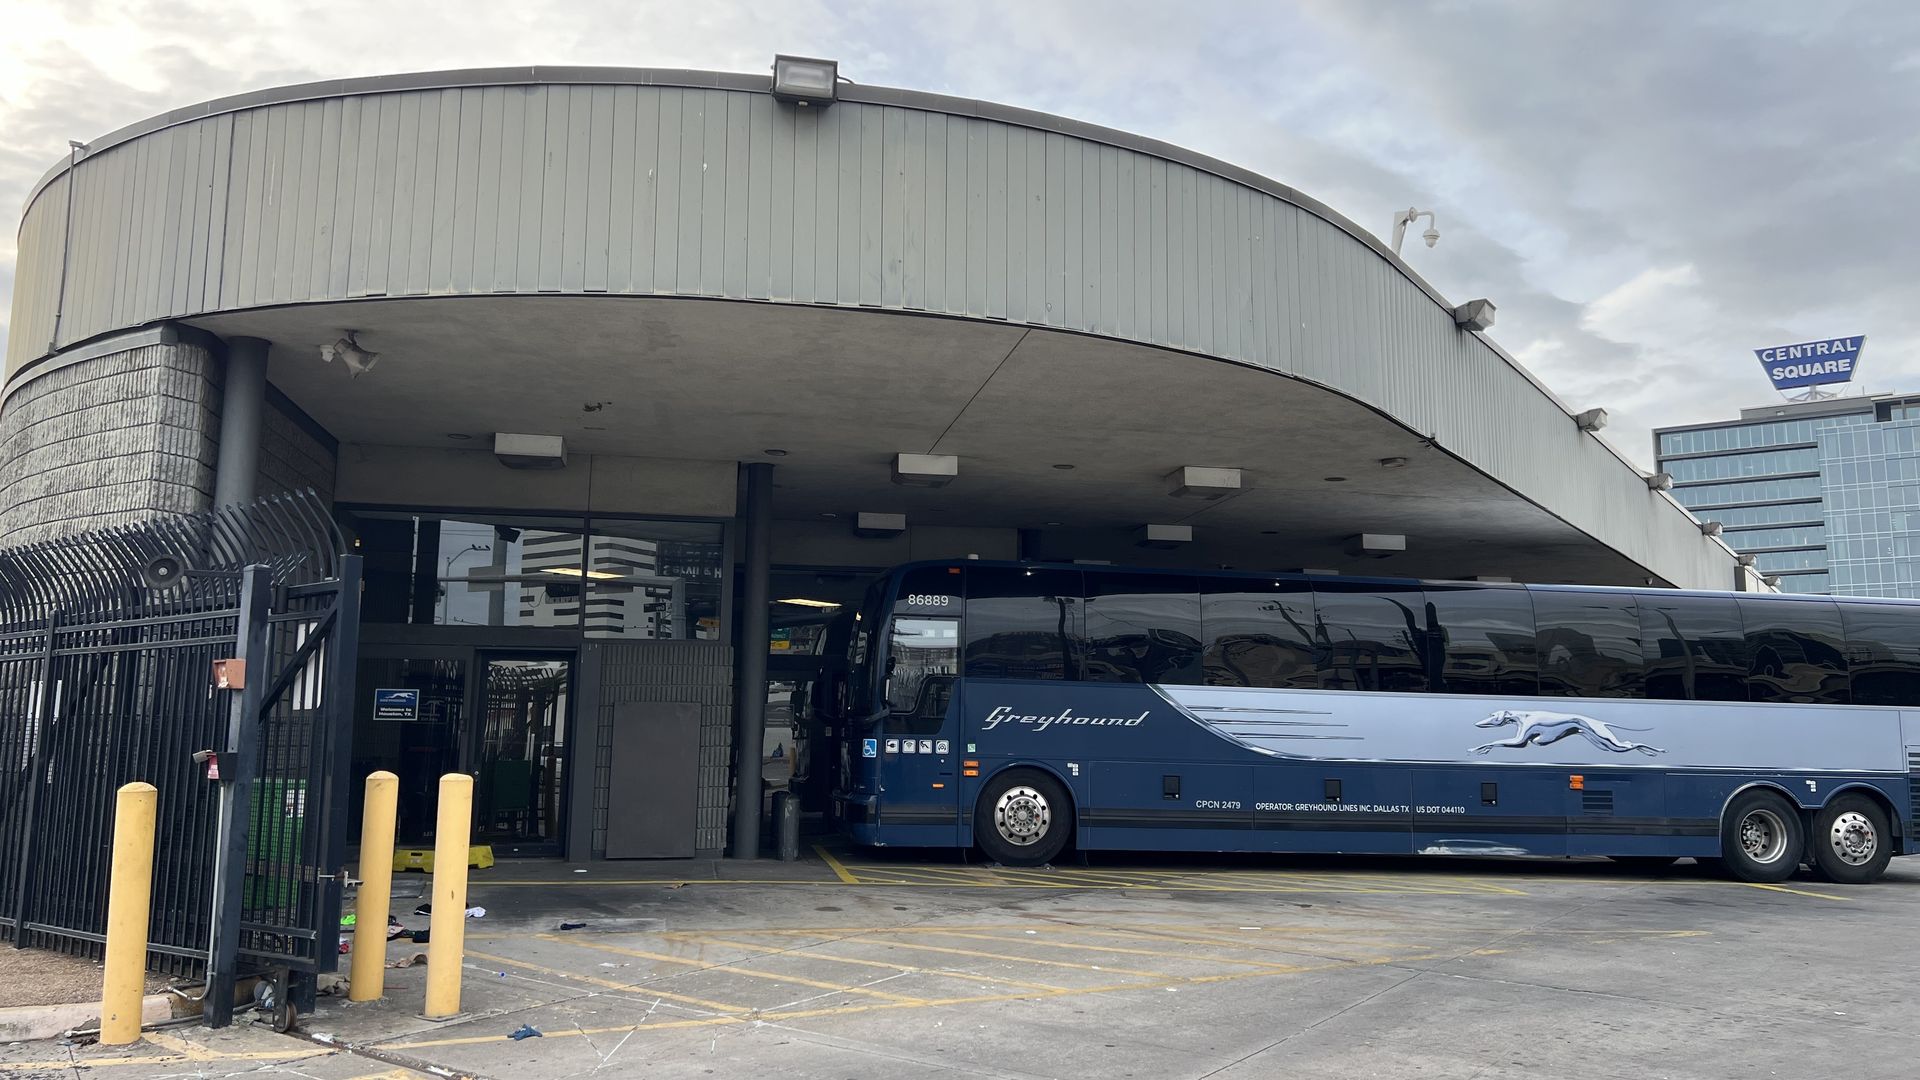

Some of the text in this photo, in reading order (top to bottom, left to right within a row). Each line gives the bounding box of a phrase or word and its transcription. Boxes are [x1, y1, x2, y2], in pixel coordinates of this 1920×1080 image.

[1762, 339, 1857, 362] CENTRAL
[1772, 359, 1851, 380] SQUARE
[908, 594, 949, 606] 86889
[982, 706, 1151, 732] Greyhound
[1195, 800, 1241, 810] CPCN 2479
[1255, 802, 1294, 811] OPERATOR:
[1295, 803, 1338, 812] GREYHOUND
[1339, 804, 1358, 812] LINES
[1373, 805, 1400, 813] DALLAS
[1400, 805, 1410, 813] TX
[1416, 805, 1466, 814] US DOT 044110
